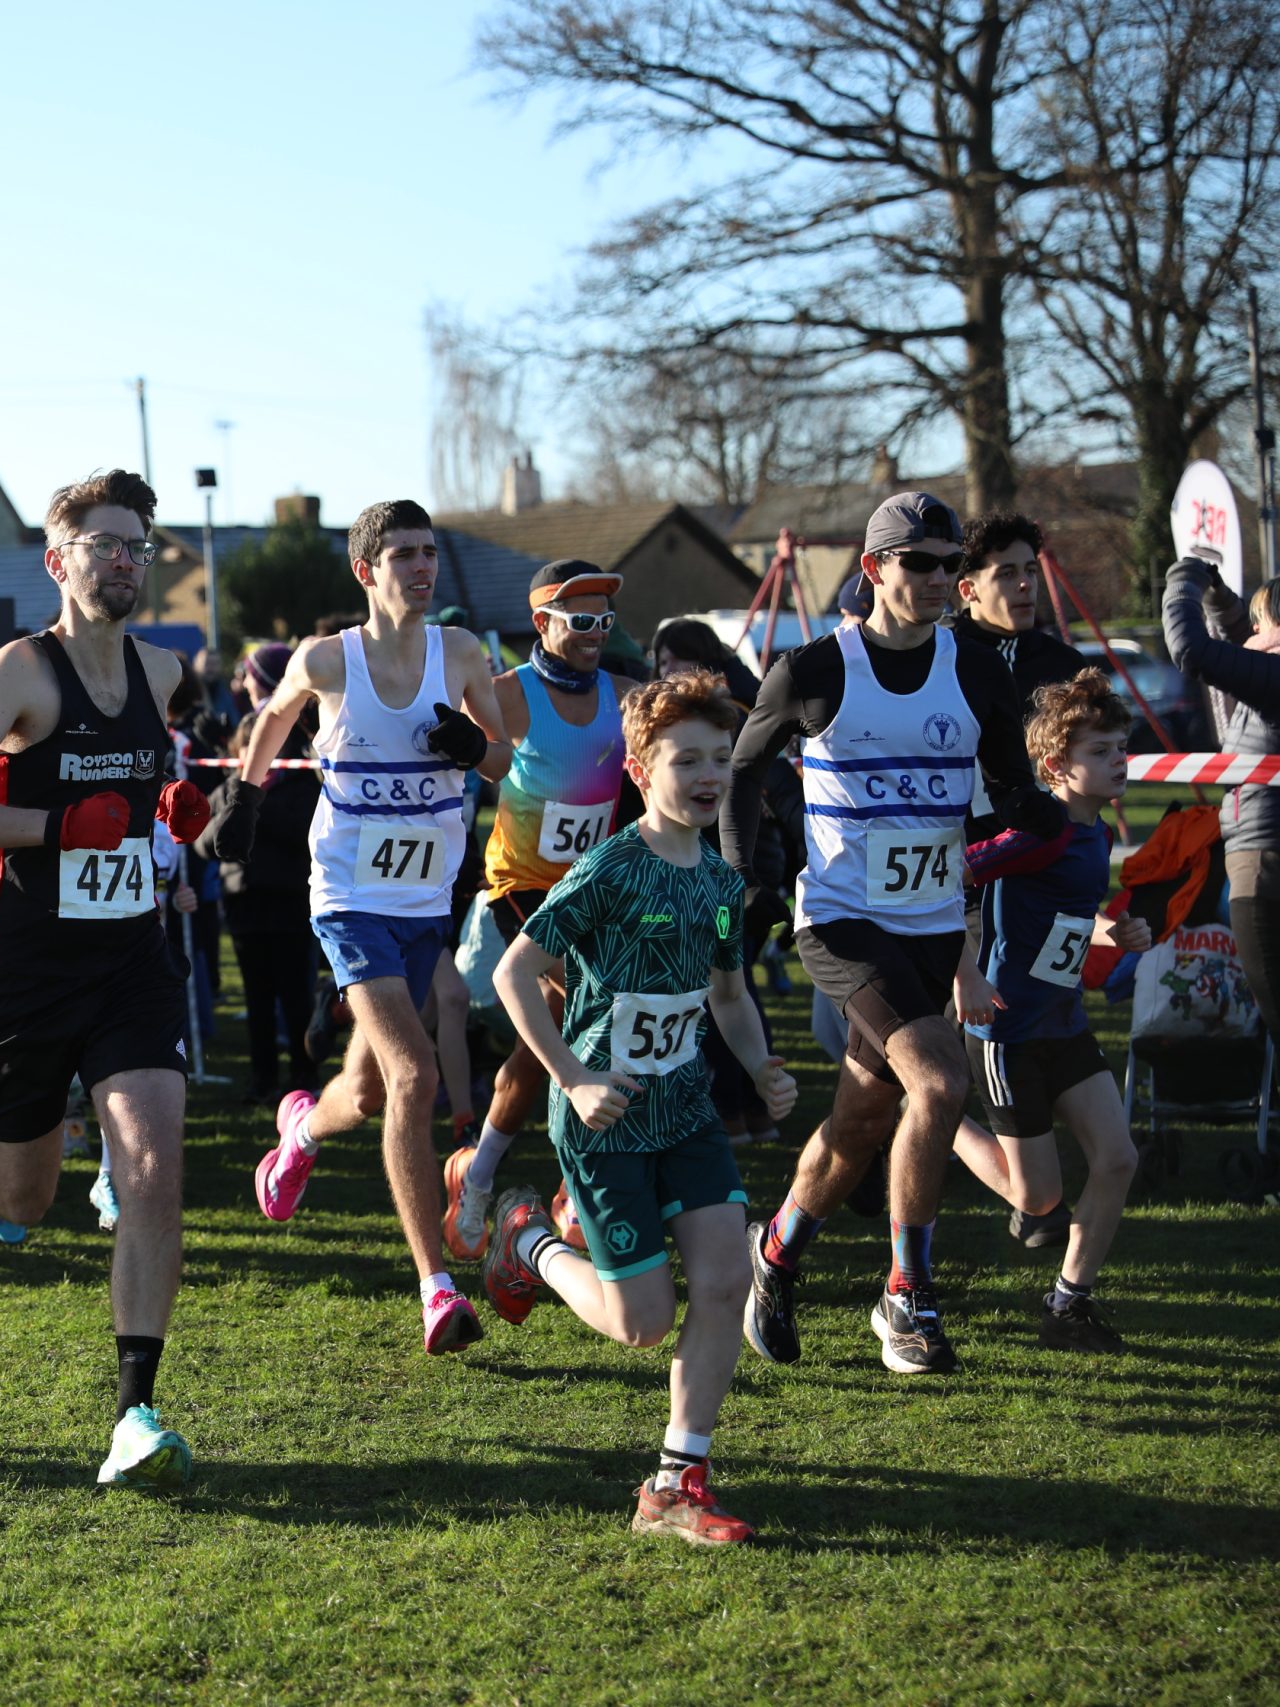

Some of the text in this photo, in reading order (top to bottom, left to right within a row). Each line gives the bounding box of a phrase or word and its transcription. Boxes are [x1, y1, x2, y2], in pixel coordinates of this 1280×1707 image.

[361, 777, 436, 800] C & C
[865, 774, 948, 799] C & C
[552, 816, 604, 854] 561
[371, 838, 434, 879] 471
[884, 844, 949, 892] 574
[77, 855, 143, 902] 474
[640, 914, 673, 923] SUDU
[1050, 931, 1091, 975] 52
[1174, 929, 1238, 957] MARV
[628, 1006, 702, 1060] 537
